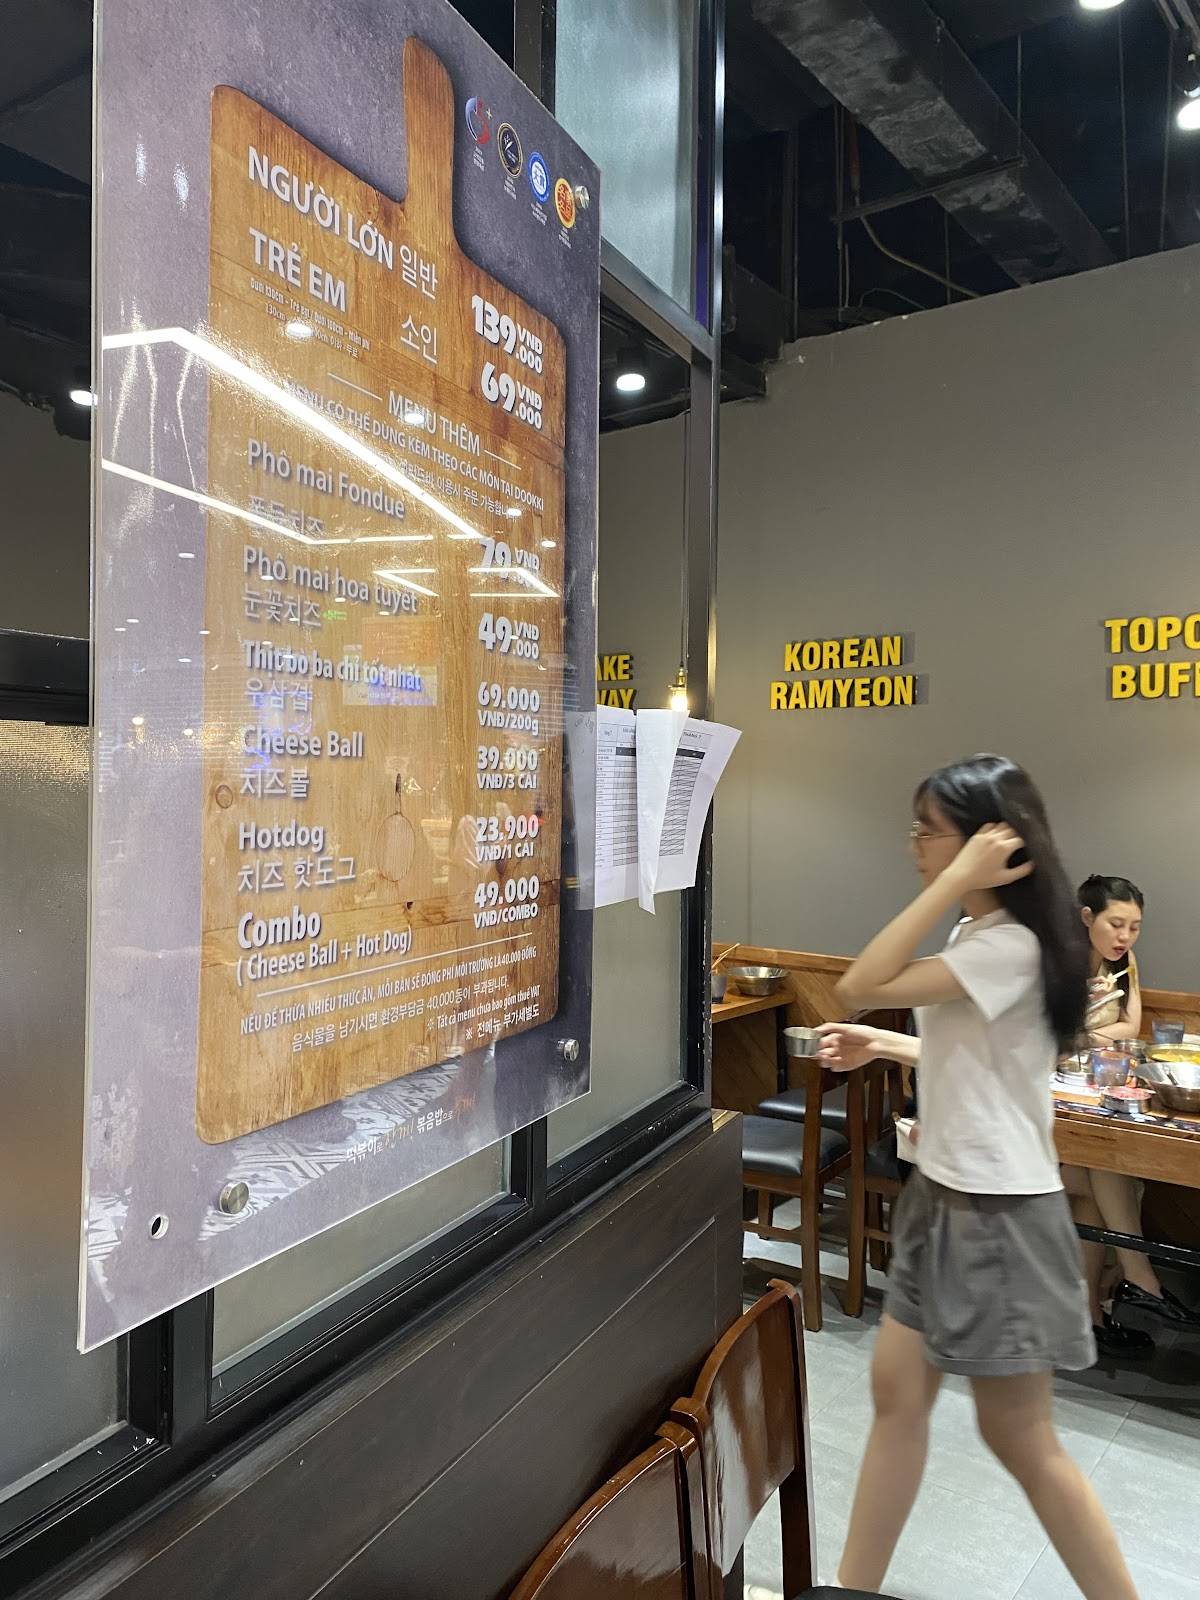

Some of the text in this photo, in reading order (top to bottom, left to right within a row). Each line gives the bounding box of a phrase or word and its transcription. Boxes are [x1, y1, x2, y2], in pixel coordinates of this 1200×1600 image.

[248, 146, 393, 271] NGƯỜI LỚN
[249, 226, 347, 312] TRẺ EM
[399, 245, 438, 300] 일반
[400, 313, 438, 365] 소인
[471, 294, 516, 354] 139
[516, 344, 543, 374] .000
[481, 361, 516, 412] 69
[516, 401, 542, 430] .000
[388, 390, 480, 456] MENU THÊM
[248, 439, 405, 518] Phô mai Fondue
[373, 418, 406, 448] DÙNG
[459, 461, 478, 481] CÁC
[479, 469, 500, 493] MÓN
[501, 480, 514, 500] TẠI
[514, 485, 544, 511] DOOKKI
[463, 488, 479, 508] 주문
[243, 544, 287, 582] Phô
[293, 563, 329, 592] mai
[335, 568, 369, 601] hoa
[479, 537, 512, 579] 79
[243, 583, 321, 627] 눈꽃치즈
[478, 613, 512, 653] 49
[513, 640, 539, 660] .000
[783, 635, 902, 672] KOREAN
[244, 640, 283, 678] Thịt
[313, 650, 333, 679] ba
[337, 655, 360, 682] chỉ
[478, 681, 540, 713] 69.000
[770, 675, 913, 710] RAMYEON
[242, 724, 364, 757] Cheese Ball
[478, 709, 539, 736] VNĐ/200g
[477, 745, 538, 771] 39.000
[240, 765, 310, 799] 치즈볼
[477, 773, 514, 789] VNĐ/3
[239, 819, 325, 852] Hotdog
[475, 814, 540, 842] 23.900
[475, 843, 512, 863] VNĐ/1
[238, 855, 356, 894] 치즈 핫도그
[474, 875, 540, 909] 49.000
[238, 905, 321, 949] Combo
[474, 902, 538, 929] VNĐ/COMBO
[309, 938, 338, 969] Ball
[342, 942, 354, 961] +
[356, 934, 381, 958] Hot
[383, 924, 412, 955] Dog)
[240, 1014, 262, 1035] NẾU
[308, 994, 336, 1017] NHIỀU
[292, 1023, 336, 1052] 음식물을
[339, 1011, 378, 1039] 남기시면
[380, 998, 424, 1026] 환경부담금
[473, 974, 511, 997] 부과됩니다.
[457, 1007, 476, 1023] menu
[530, 985, 541, 999] VAT
[476, 1017, 502, 1038] 전메뉴
[503, 1003, 540, 1028] 부가세별도
[416, 1108, 453, 1135] 볶음밥으로
